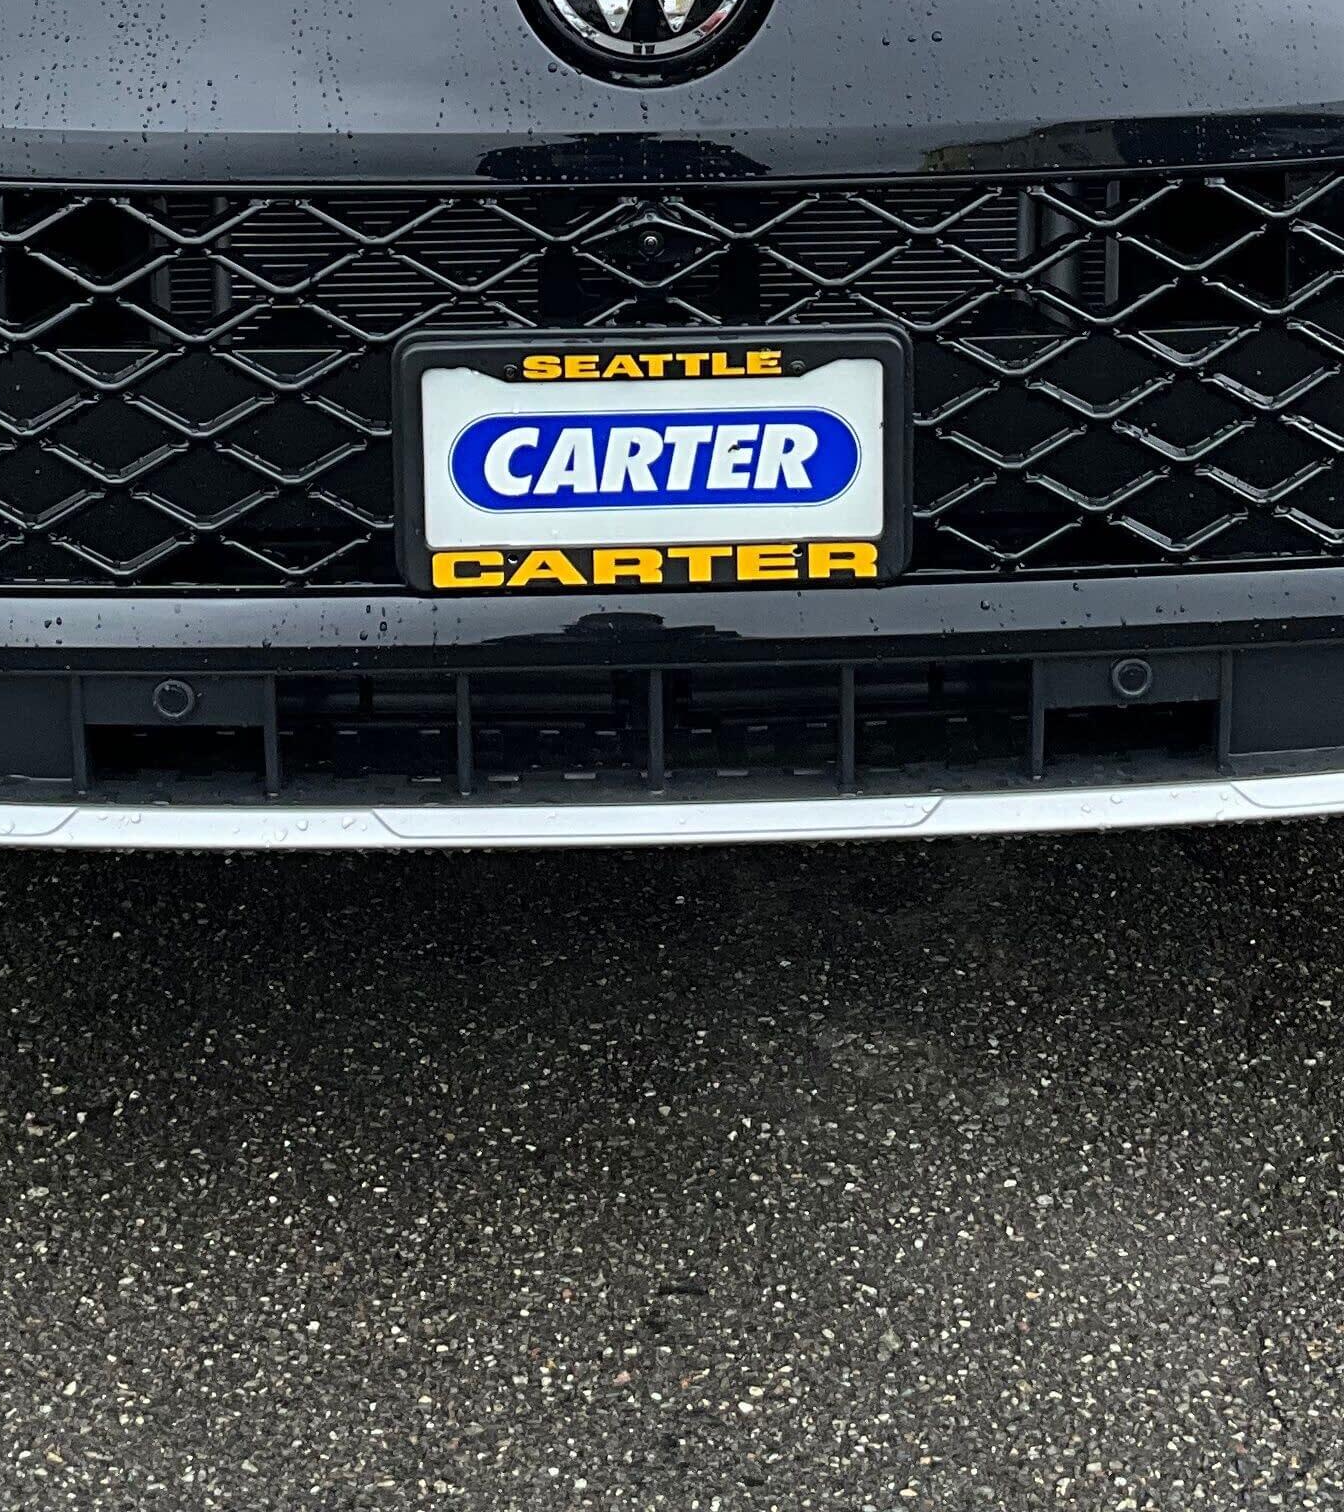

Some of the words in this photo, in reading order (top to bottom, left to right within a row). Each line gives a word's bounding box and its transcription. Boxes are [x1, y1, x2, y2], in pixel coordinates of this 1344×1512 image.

[522, 350, 782, 379] SEATTLE
[483, 423, 819, 497] CARTER
[431, 542, 878, 588] CARTER
